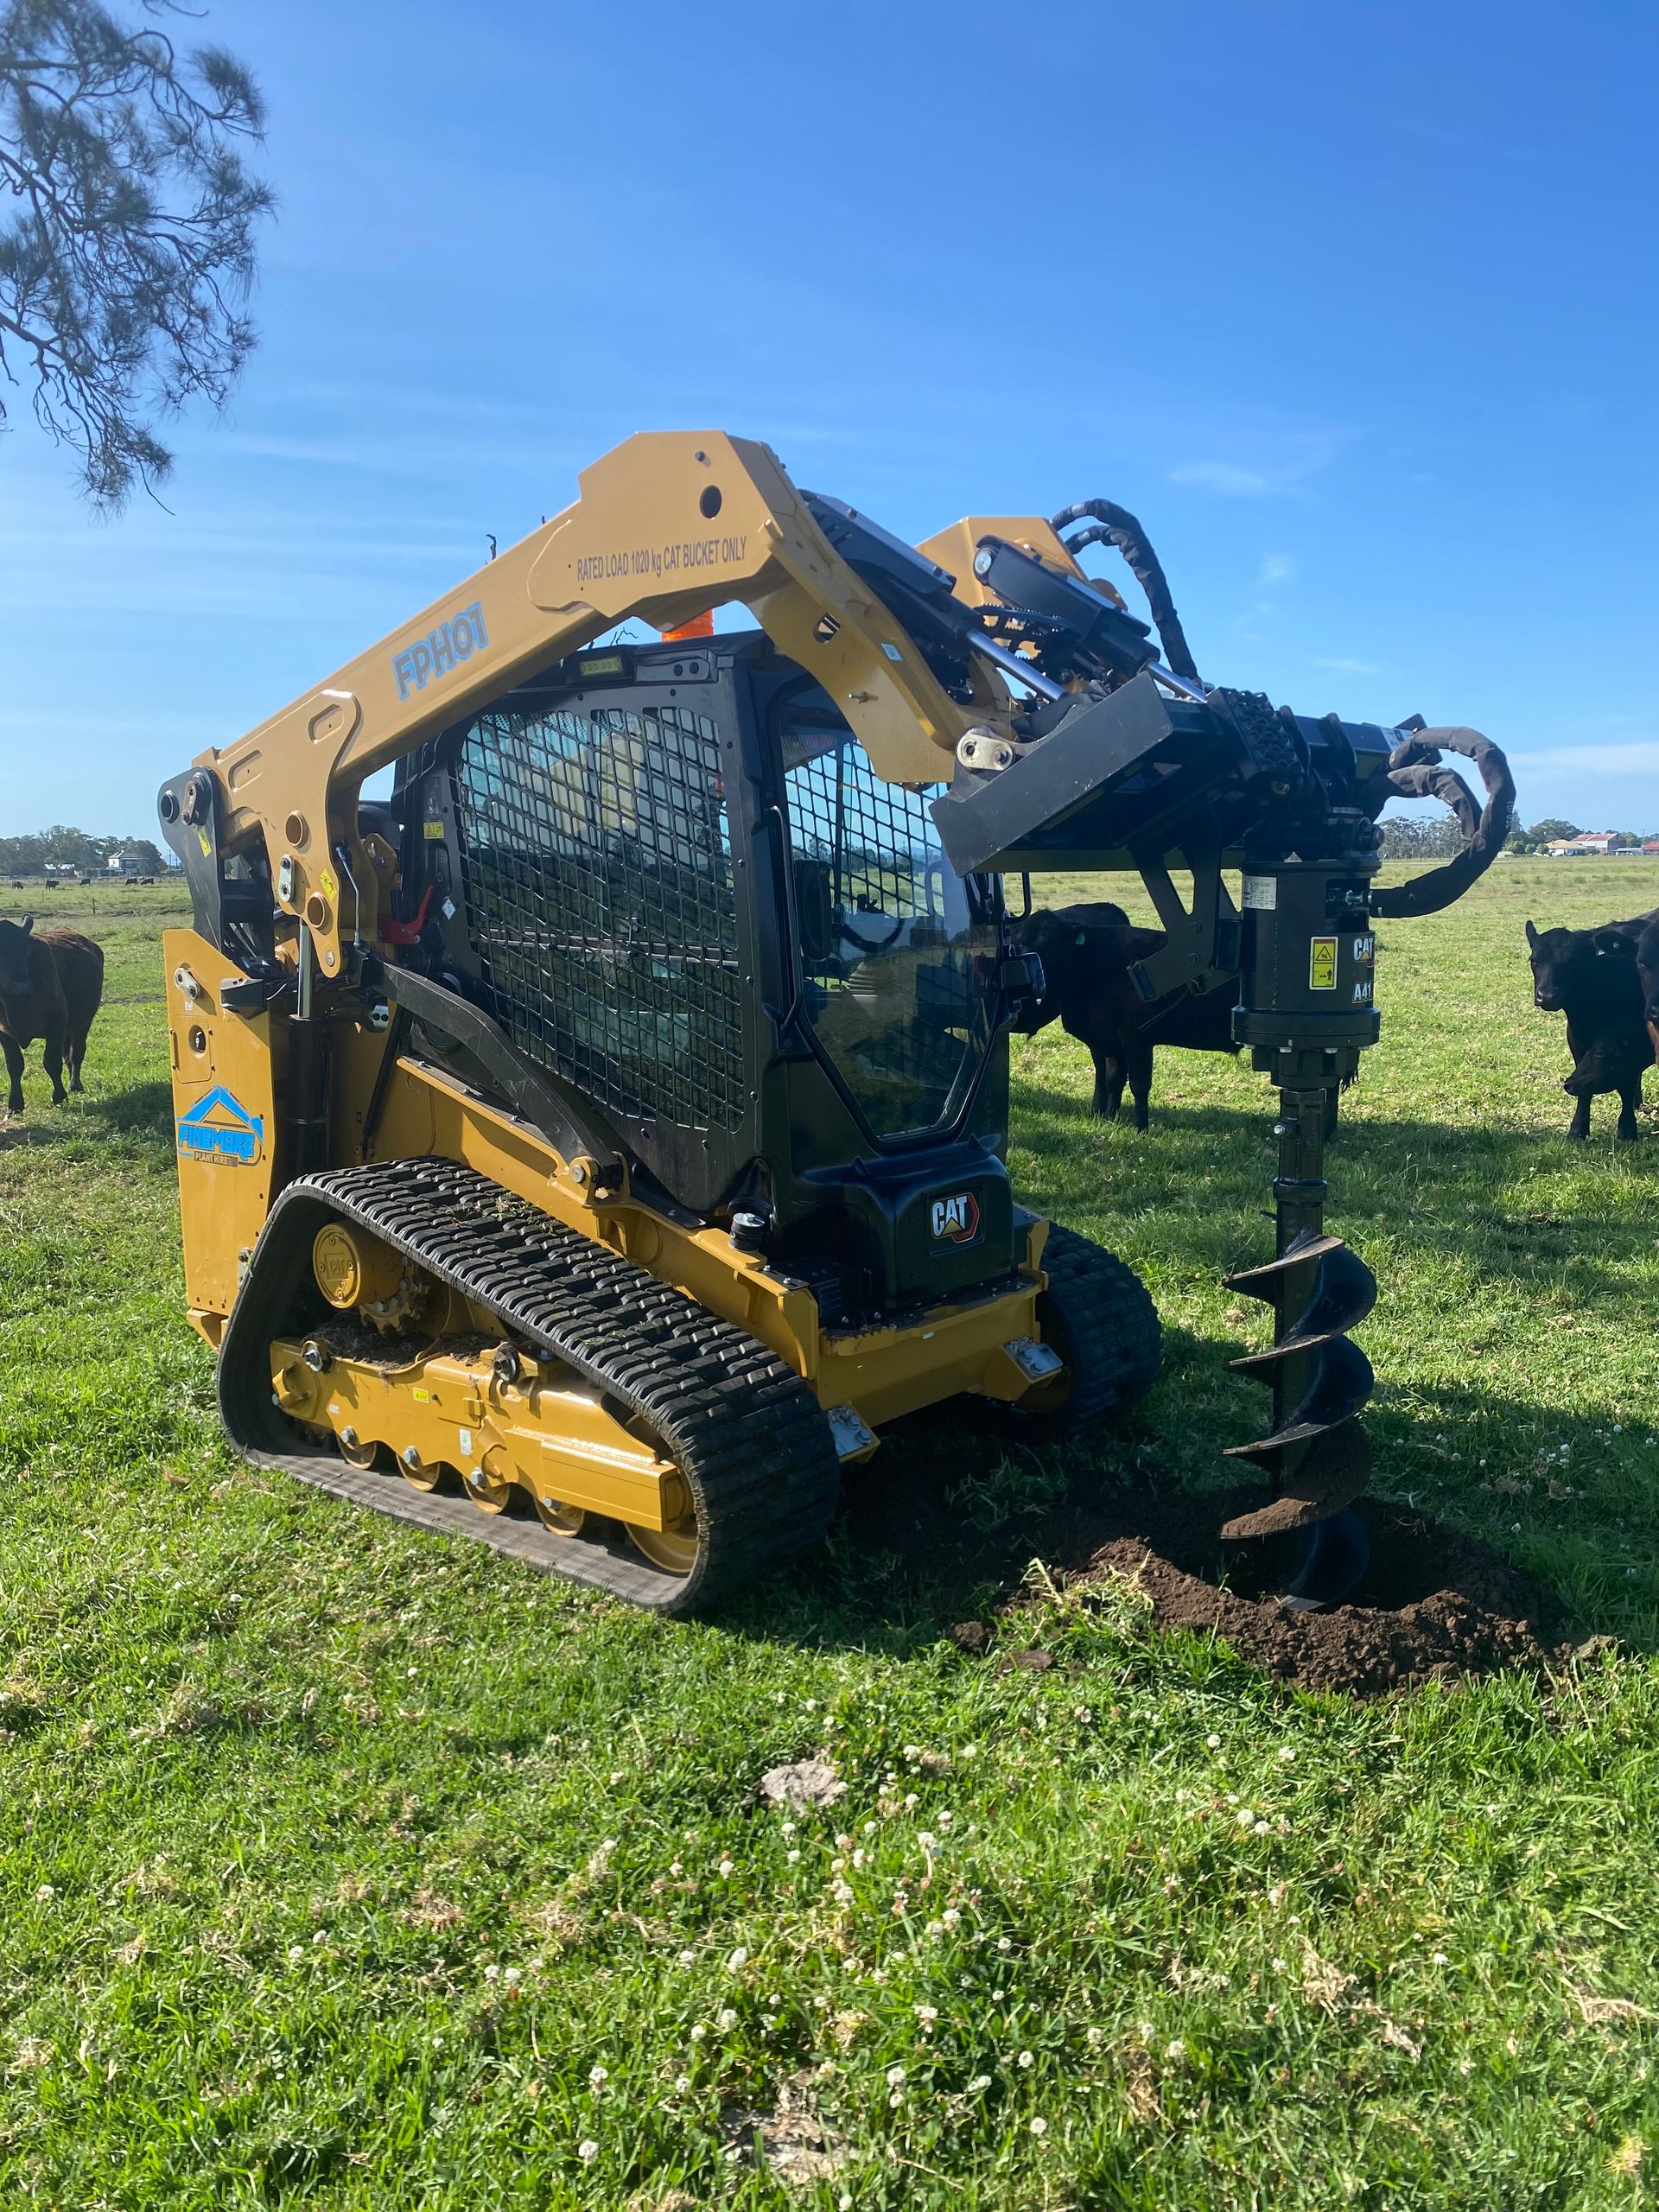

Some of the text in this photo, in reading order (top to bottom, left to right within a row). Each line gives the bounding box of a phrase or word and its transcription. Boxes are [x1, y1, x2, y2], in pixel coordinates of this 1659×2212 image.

[577, 535, 747, 581] RATED LOAD 1020 kg CAT BUCKET ONLY
[1354, 938, 1374, 961] CAT
[178, 1123, 255, 1161] FINEMORE
[195, 1152, 213, 1162] PLANT
[931, 1195, 968, 1237] CAT
